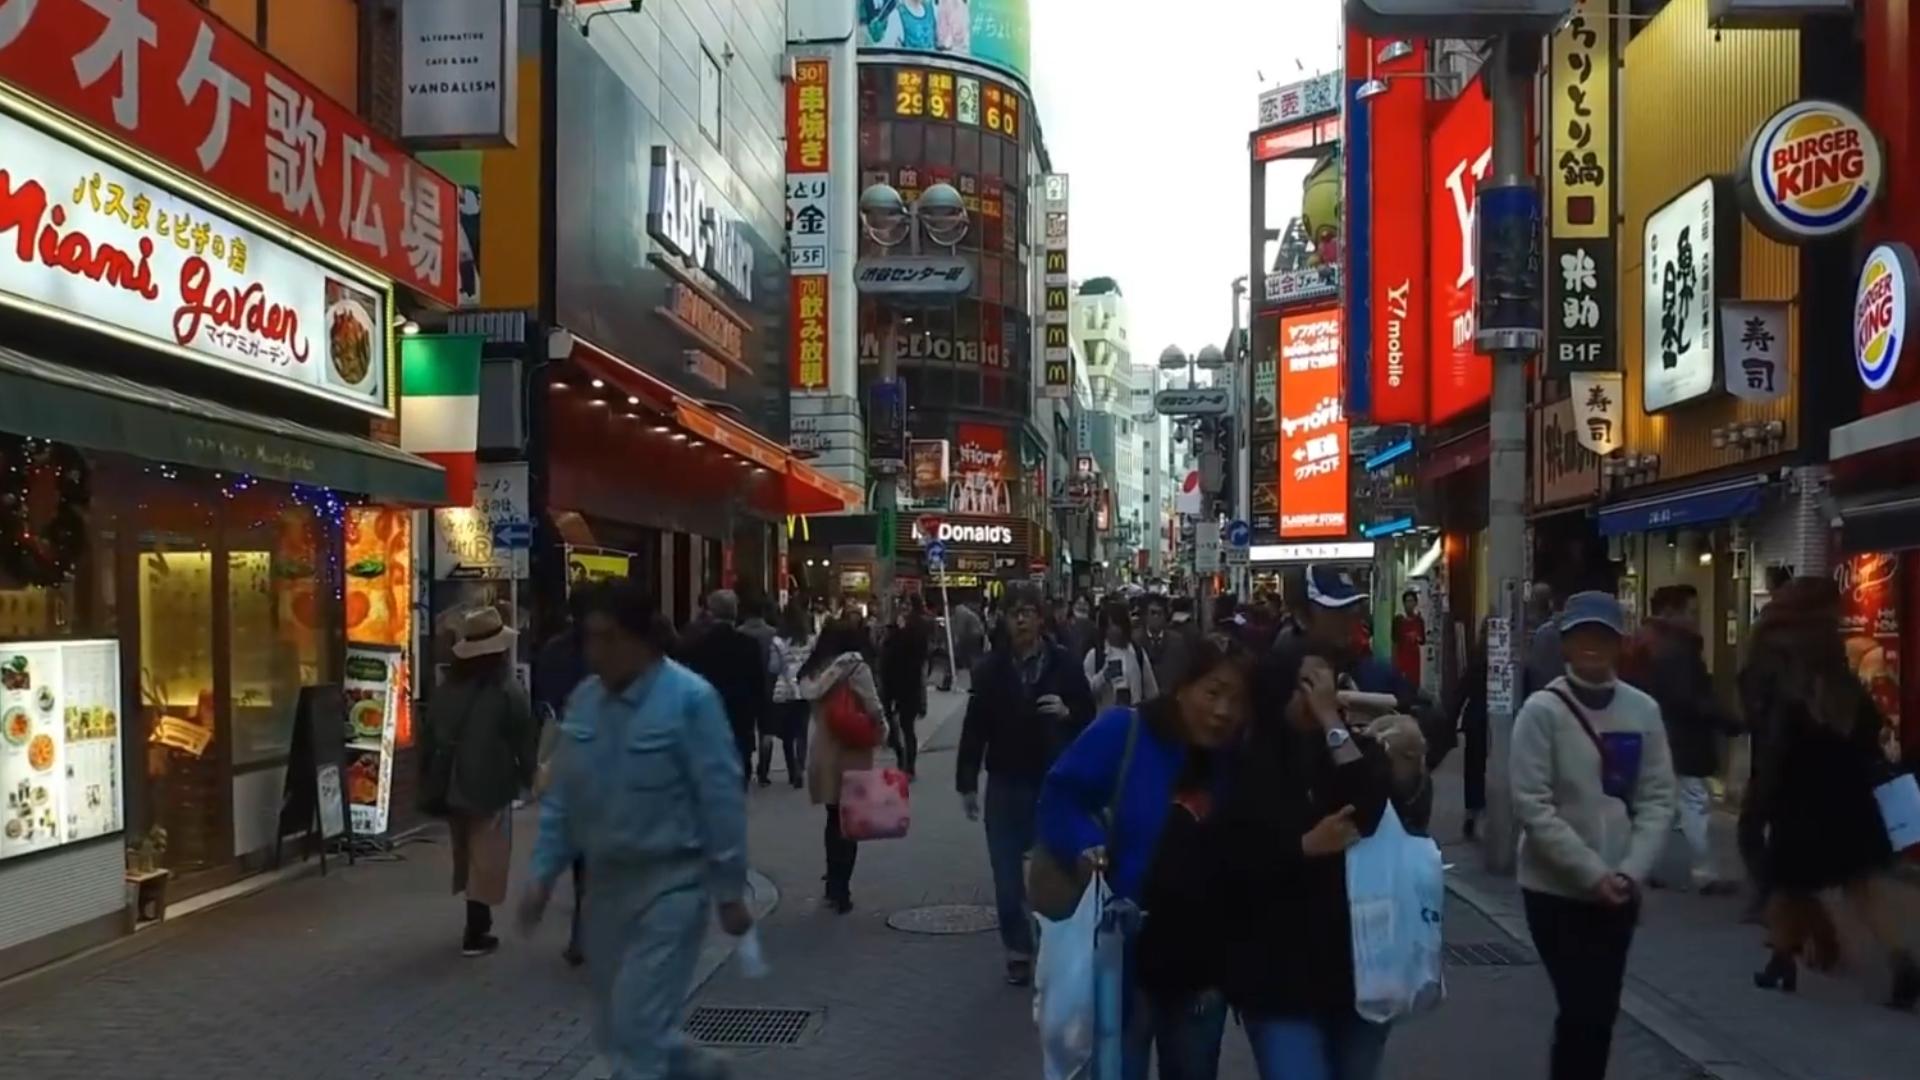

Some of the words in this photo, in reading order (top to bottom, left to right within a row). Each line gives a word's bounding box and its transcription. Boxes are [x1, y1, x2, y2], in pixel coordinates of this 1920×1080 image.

[408, 81, 496, 94] VANDALISM
[798, 85, 826, 167] 串焼き
[1773, 128, 1860, 172] BURGER
[1777, 149, 1864, 203] KING
[861, 267, 965, 281] 渋谷センター街
[1560, 248, 1600, 328] 米助
[1559, 344, 1601, 361] B1F
[1741, 316, 1775, 392] 寿司
[1586, 385, 1612, 443] 寿司
[911, 523, 1012, 543] Donald's
